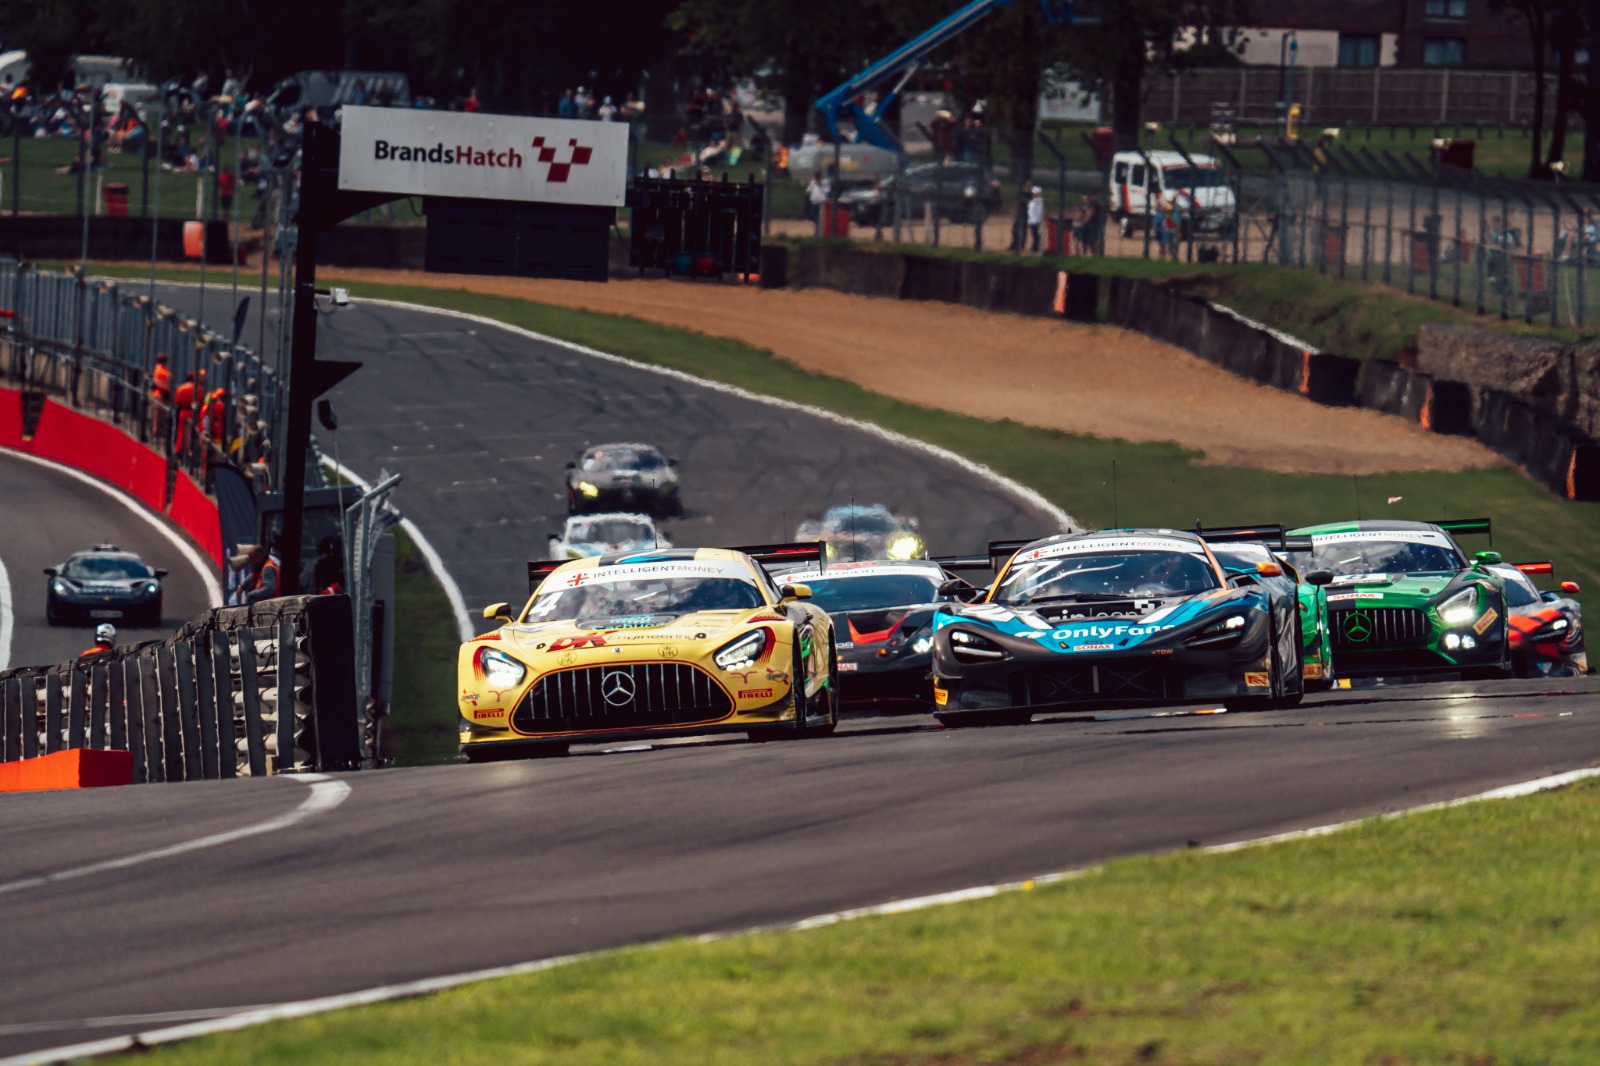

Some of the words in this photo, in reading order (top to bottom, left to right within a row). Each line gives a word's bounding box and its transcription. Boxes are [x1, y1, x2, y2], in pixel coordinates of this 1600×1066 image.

[374, 140, 522, 168] BrandsHatch
[1052, 541, 1184, 553] INTELLIGENTMONEY
[593, 565, 724, 578] INTELLIGENTMONEY
[529, 591, 564, 616] 4
[546, 630, 619, 652] DK
[738, 688, 773, 699] PIRELLI
[474, 708, 504, 719] PIRELLI
